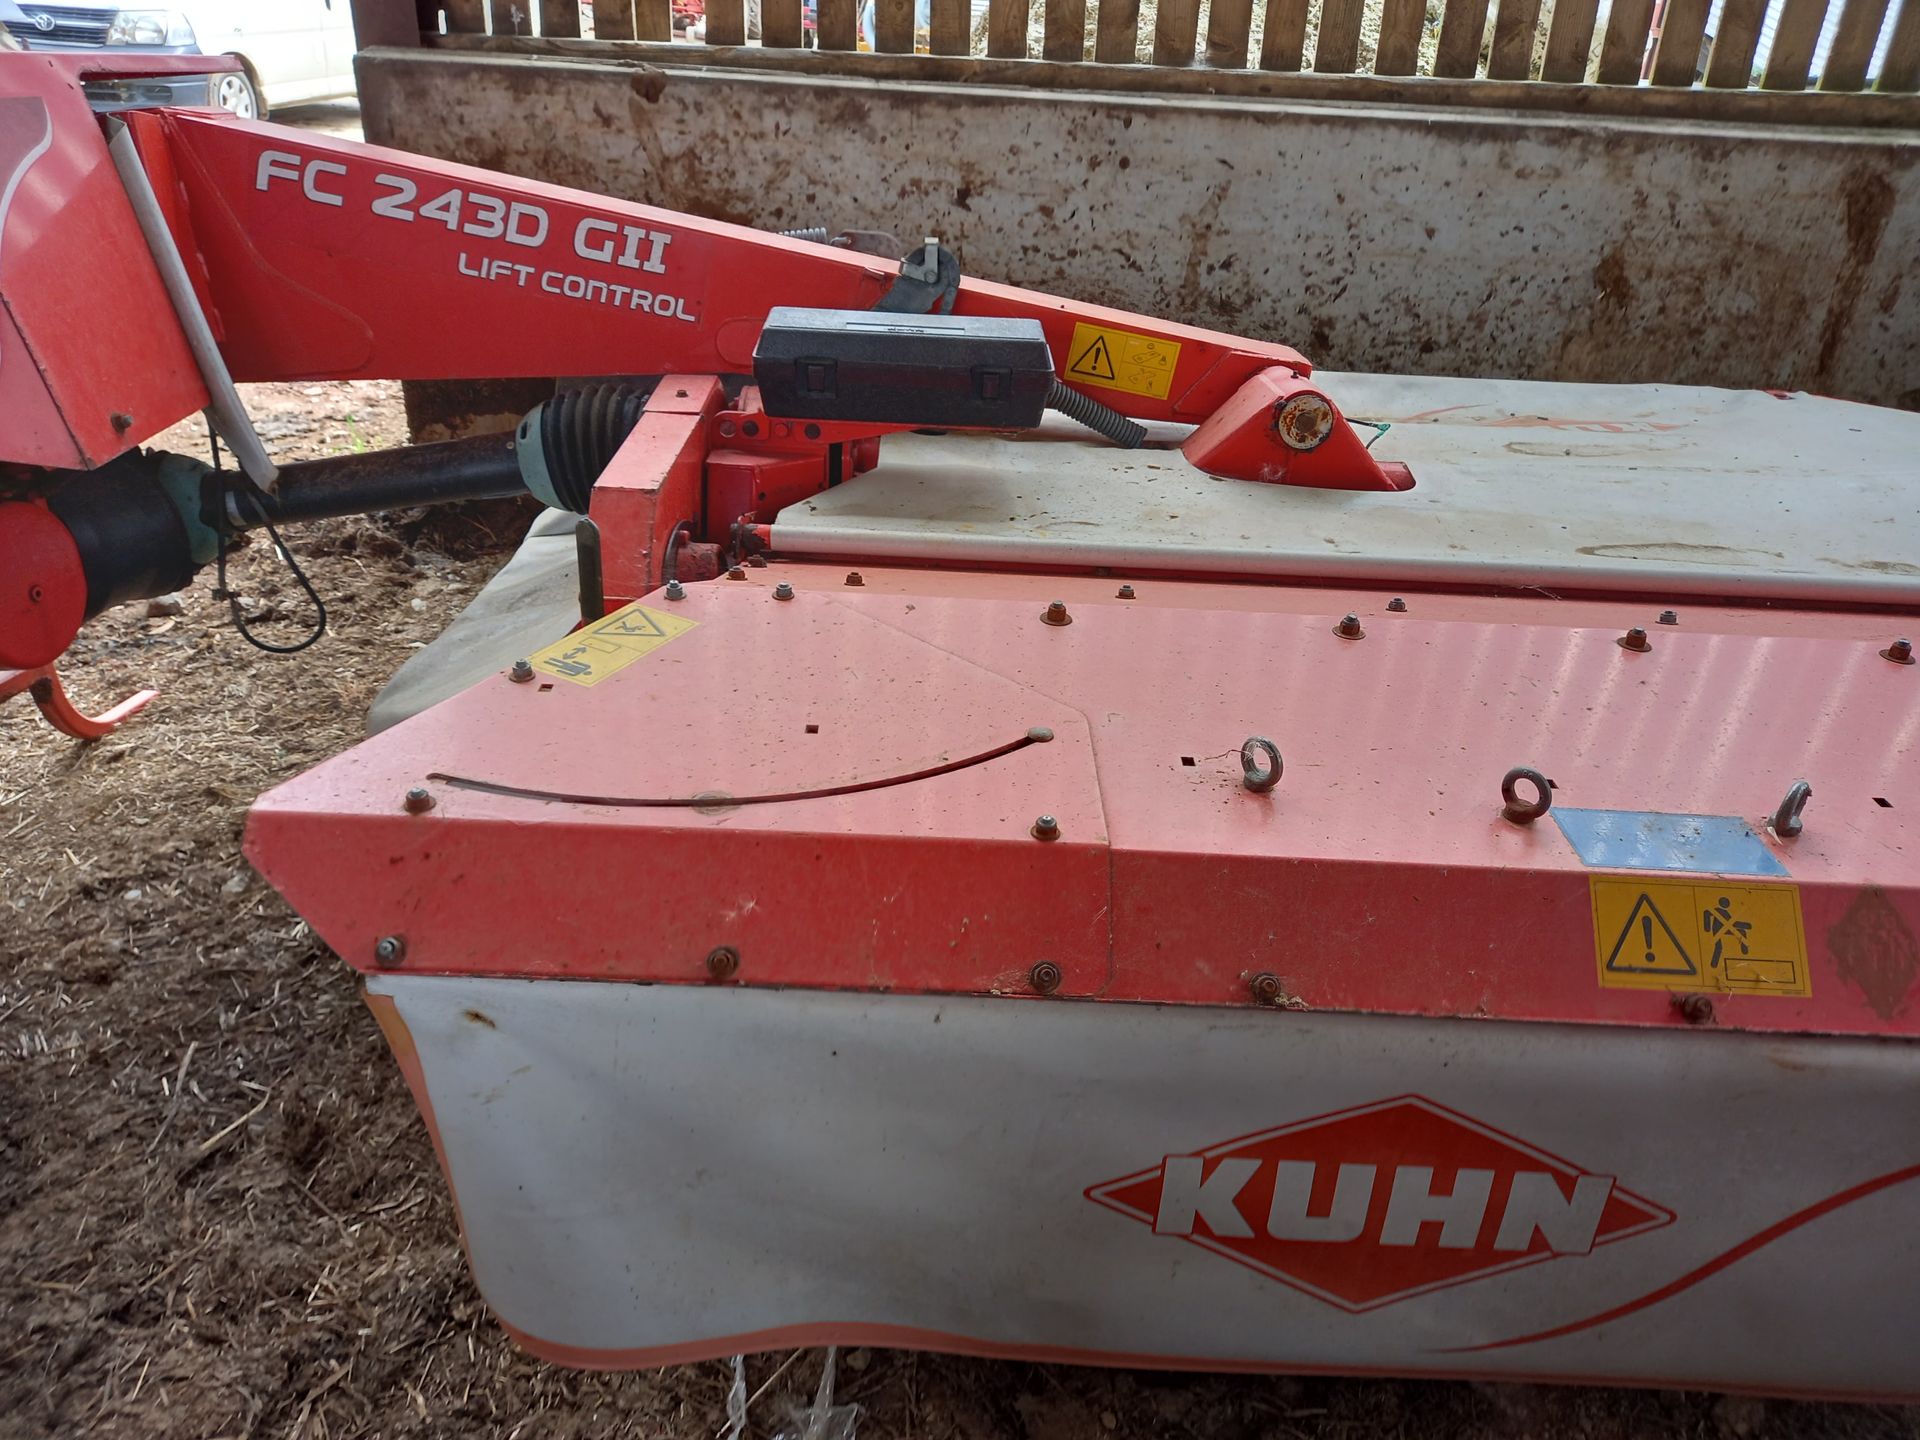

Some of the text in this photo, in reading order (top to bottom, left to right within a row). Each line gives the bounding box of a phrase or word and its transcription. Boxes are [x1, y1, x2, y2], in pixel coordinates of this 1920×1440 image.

[255, 149, 672, 274] FC 243D GII
[457, 252, 696, 323] LIFT CONTROL
[1153, 1154, 1616, 1255] KUHN
